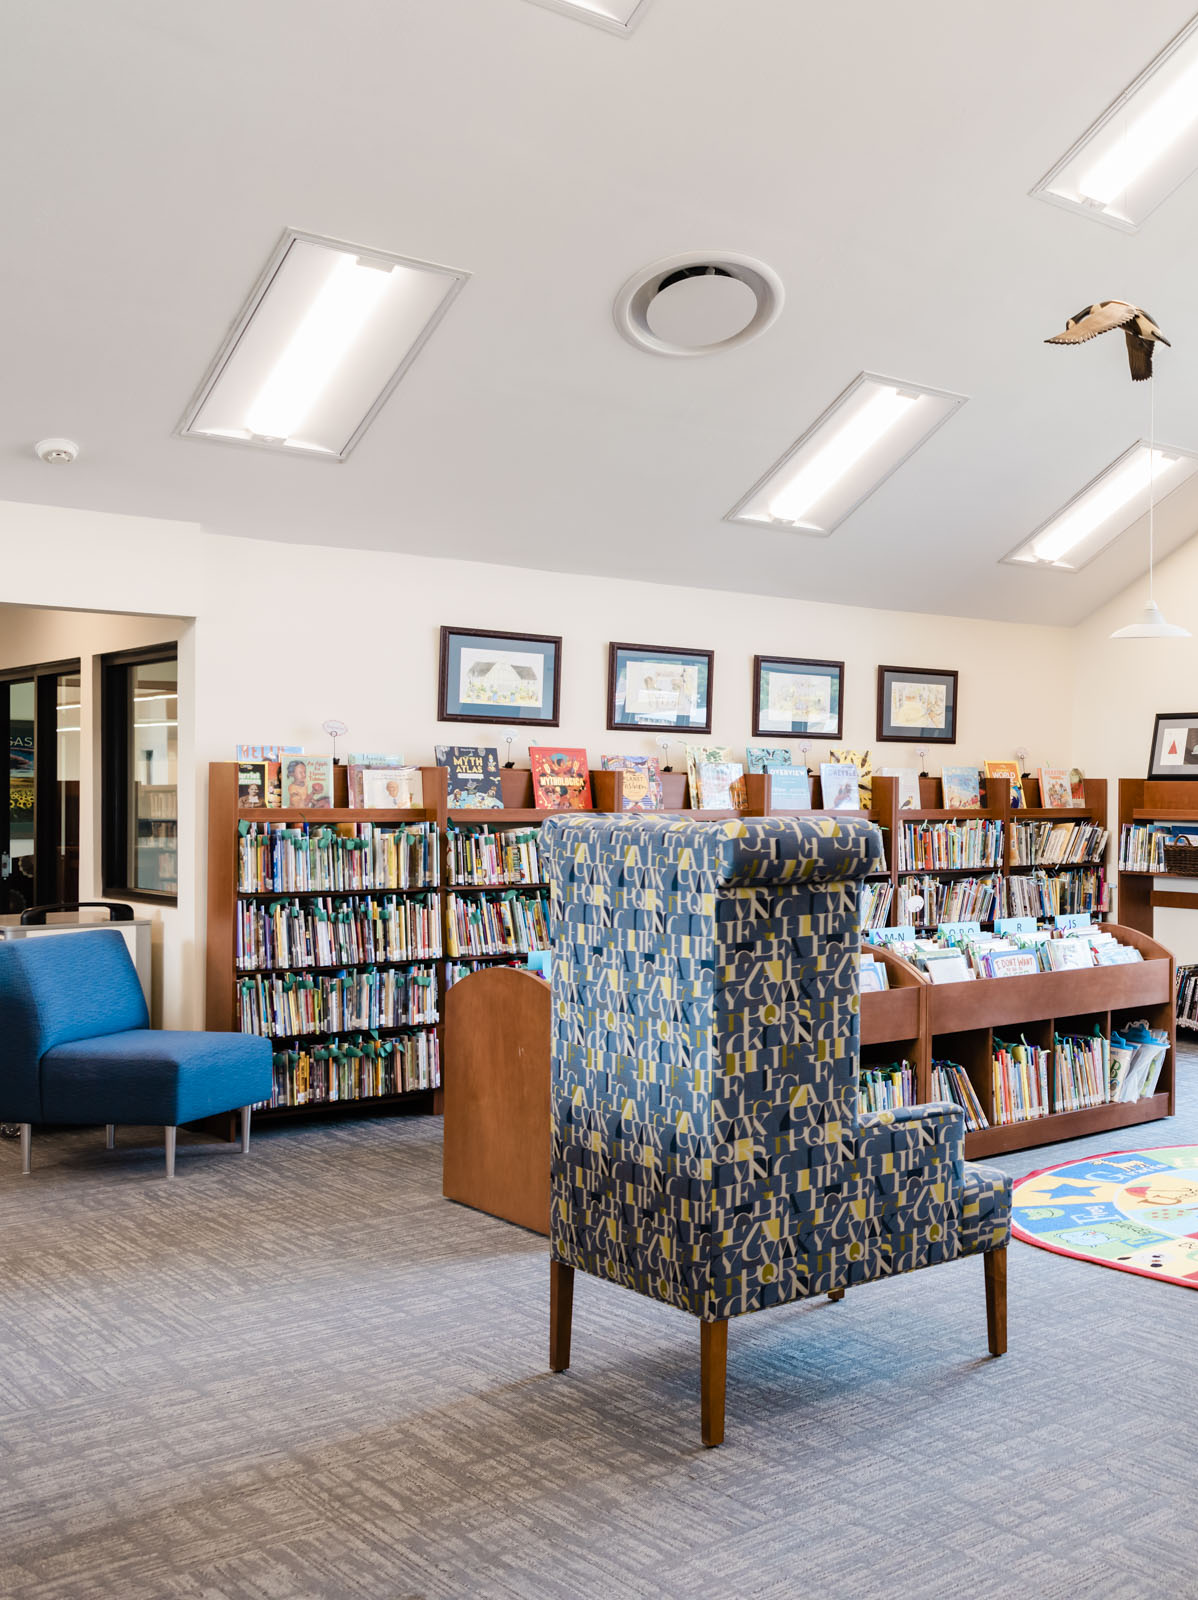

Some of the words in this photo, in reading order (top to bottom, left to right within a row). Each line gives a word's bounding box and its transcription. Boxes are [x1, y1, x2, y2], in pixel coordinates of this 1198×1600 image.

[453, 756, 483, 766] MYTH
[1016, 922, 1023, 932] R
[1018, 957, 1033, 967] WANT
